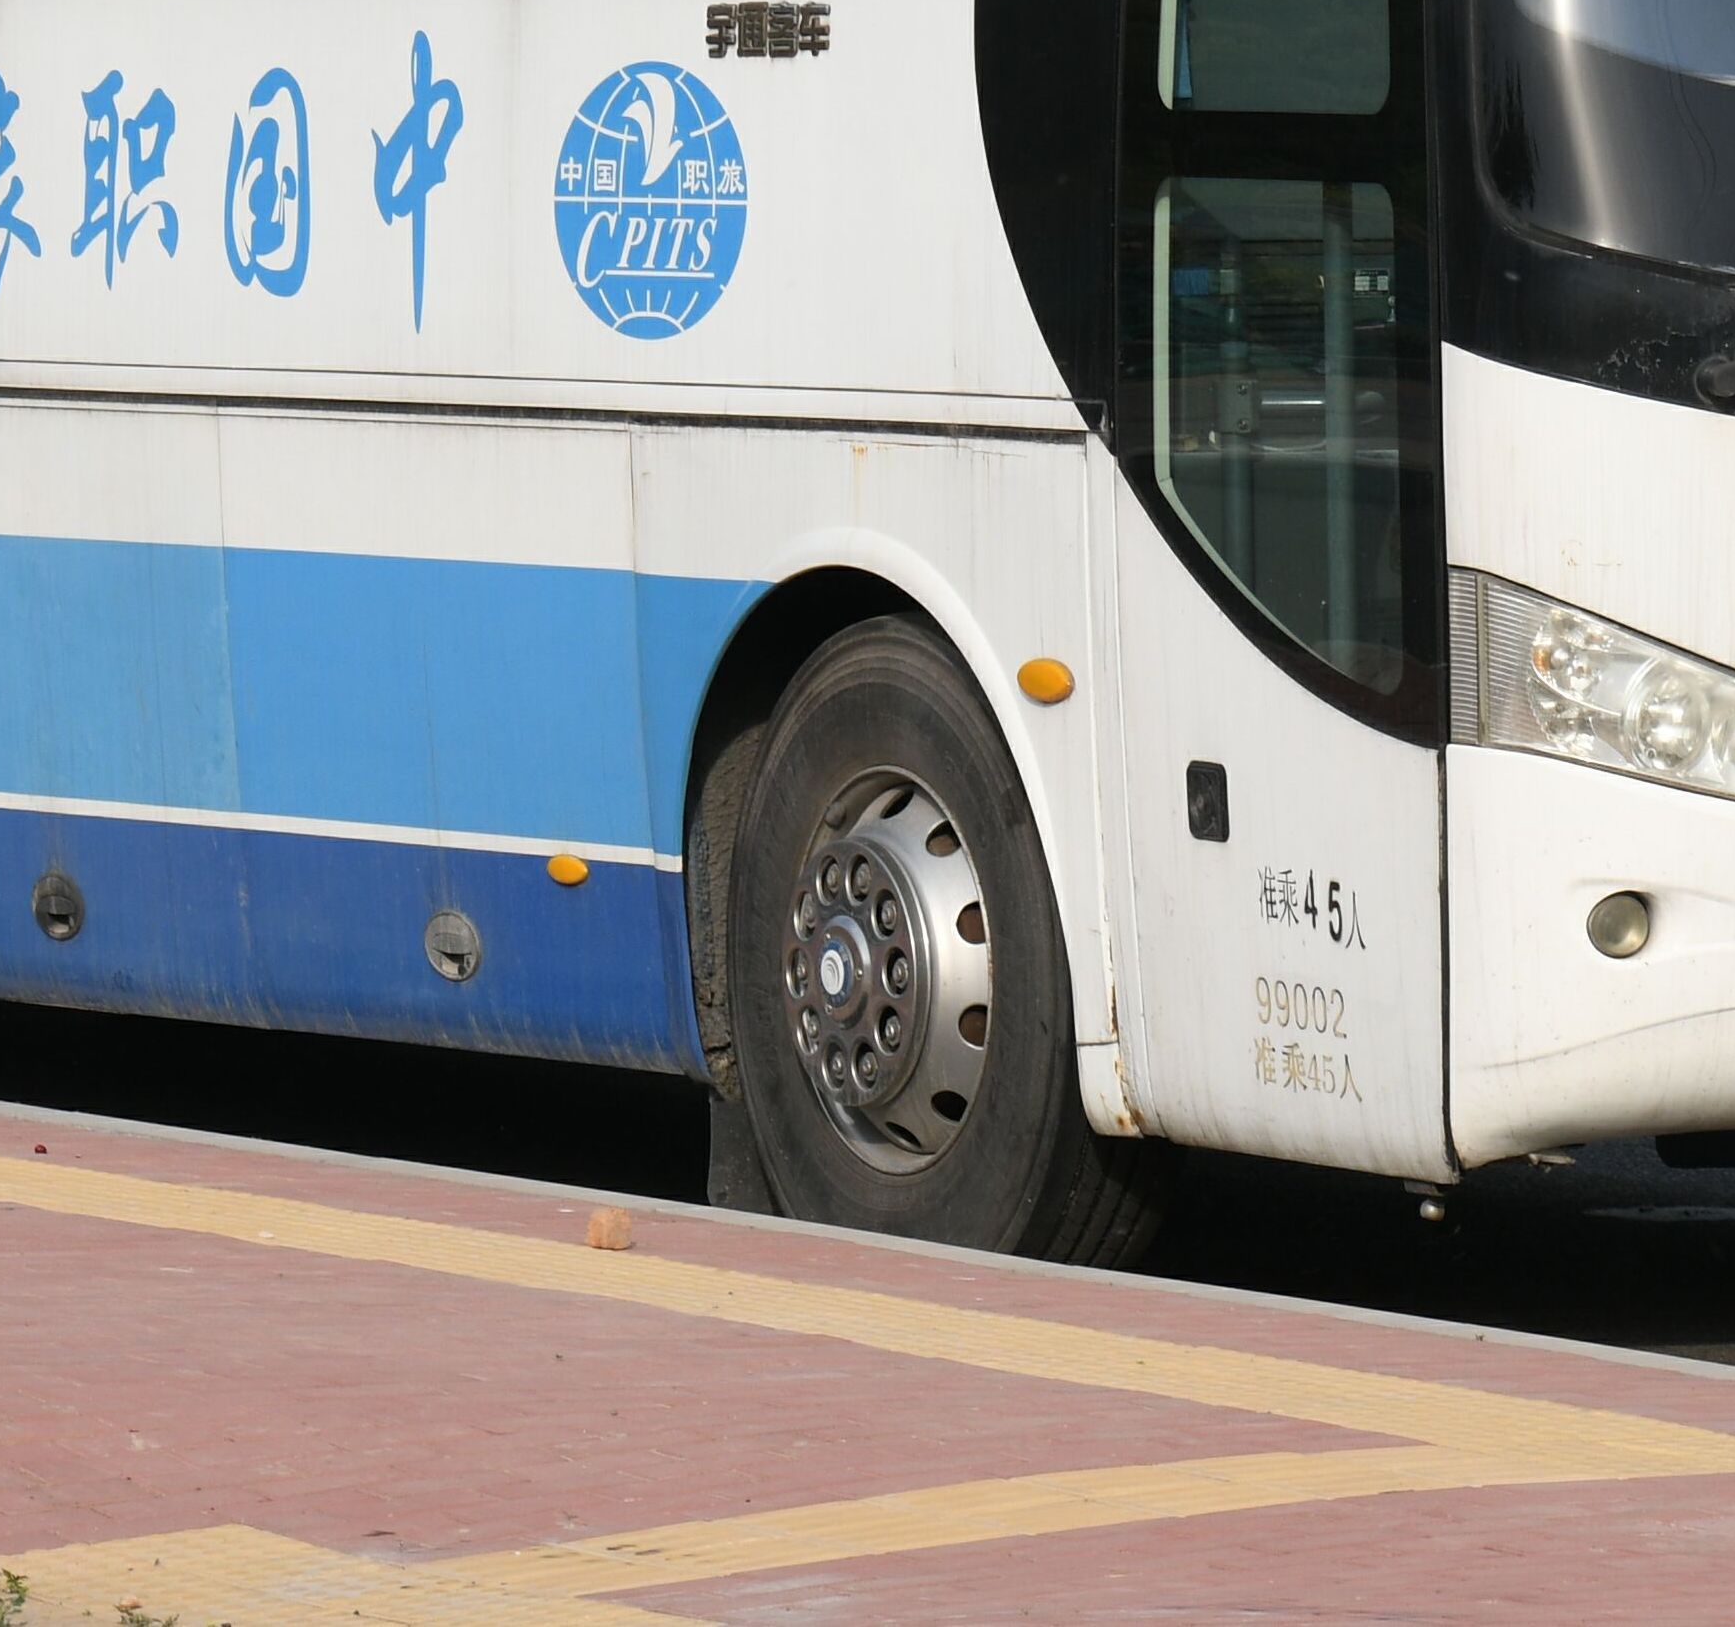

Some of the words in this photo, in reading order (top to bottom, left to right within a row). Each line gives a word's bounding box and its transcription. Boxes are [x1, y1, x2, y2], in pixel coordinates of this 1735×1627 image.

[705, 2, 831, 58] 宇通客车
[576, 211, 717, 289] CPITS
[1255, 976, 1348, 1039] 99002
